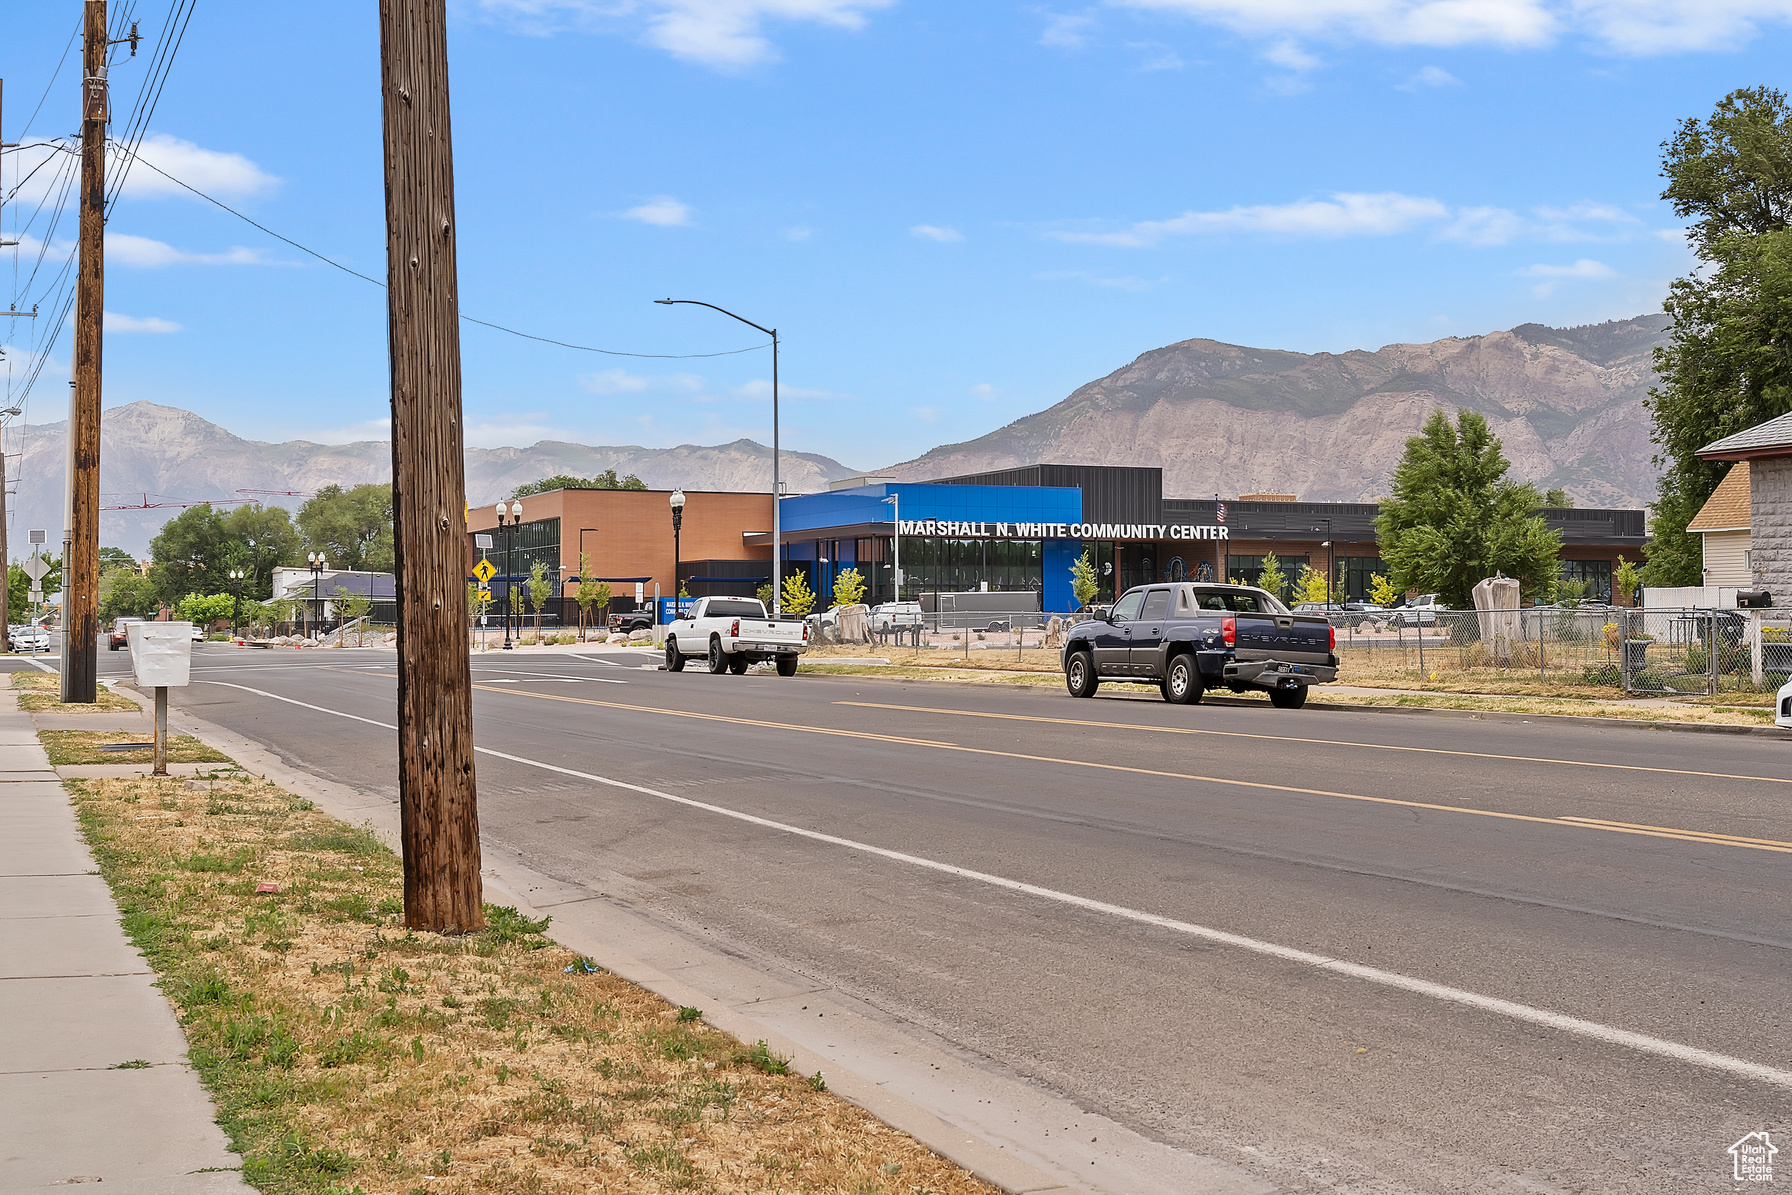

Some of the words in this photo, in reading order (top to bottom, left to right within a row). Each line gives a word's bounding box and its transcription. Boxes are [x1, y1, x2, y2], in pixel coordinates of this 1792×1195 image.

[899, 520, 990, 536] MARSHALL
[996, 522, 1012, 537] N.
[1015, 522, 1067, 537] WHITE
[1070, 523, 1167, 539] COMMUNITY
[1170, 524, 1229, 540] CENTER
[1241, 634, 1325, 645] CHEVROLET
